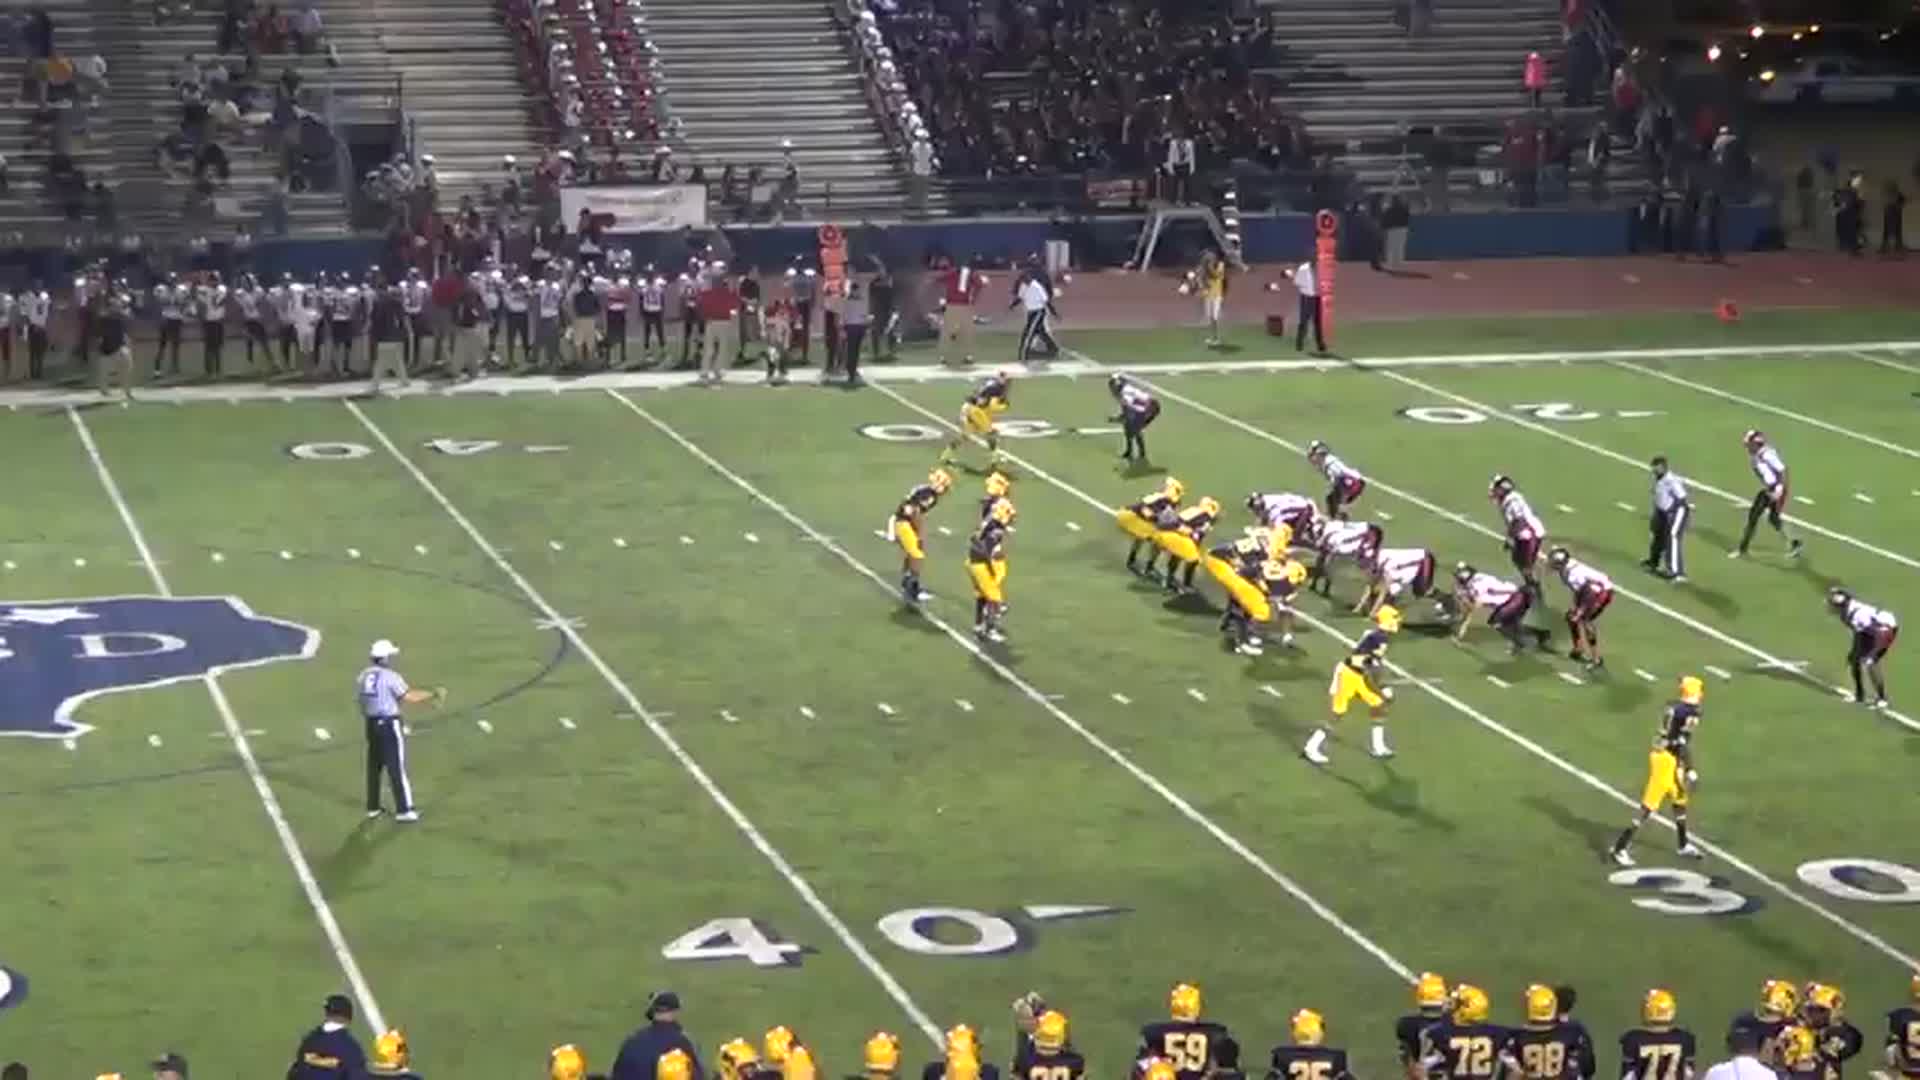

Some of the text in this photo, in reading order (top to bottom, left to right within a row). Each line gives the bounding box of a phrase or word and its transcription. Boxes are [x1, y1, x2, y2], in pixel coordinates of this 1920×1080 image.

[1164, 1033, 1207, 1072] 59
[1450, 1036, 1493, 1076] 72
[1639, 1043, 1681, 1080] 77
